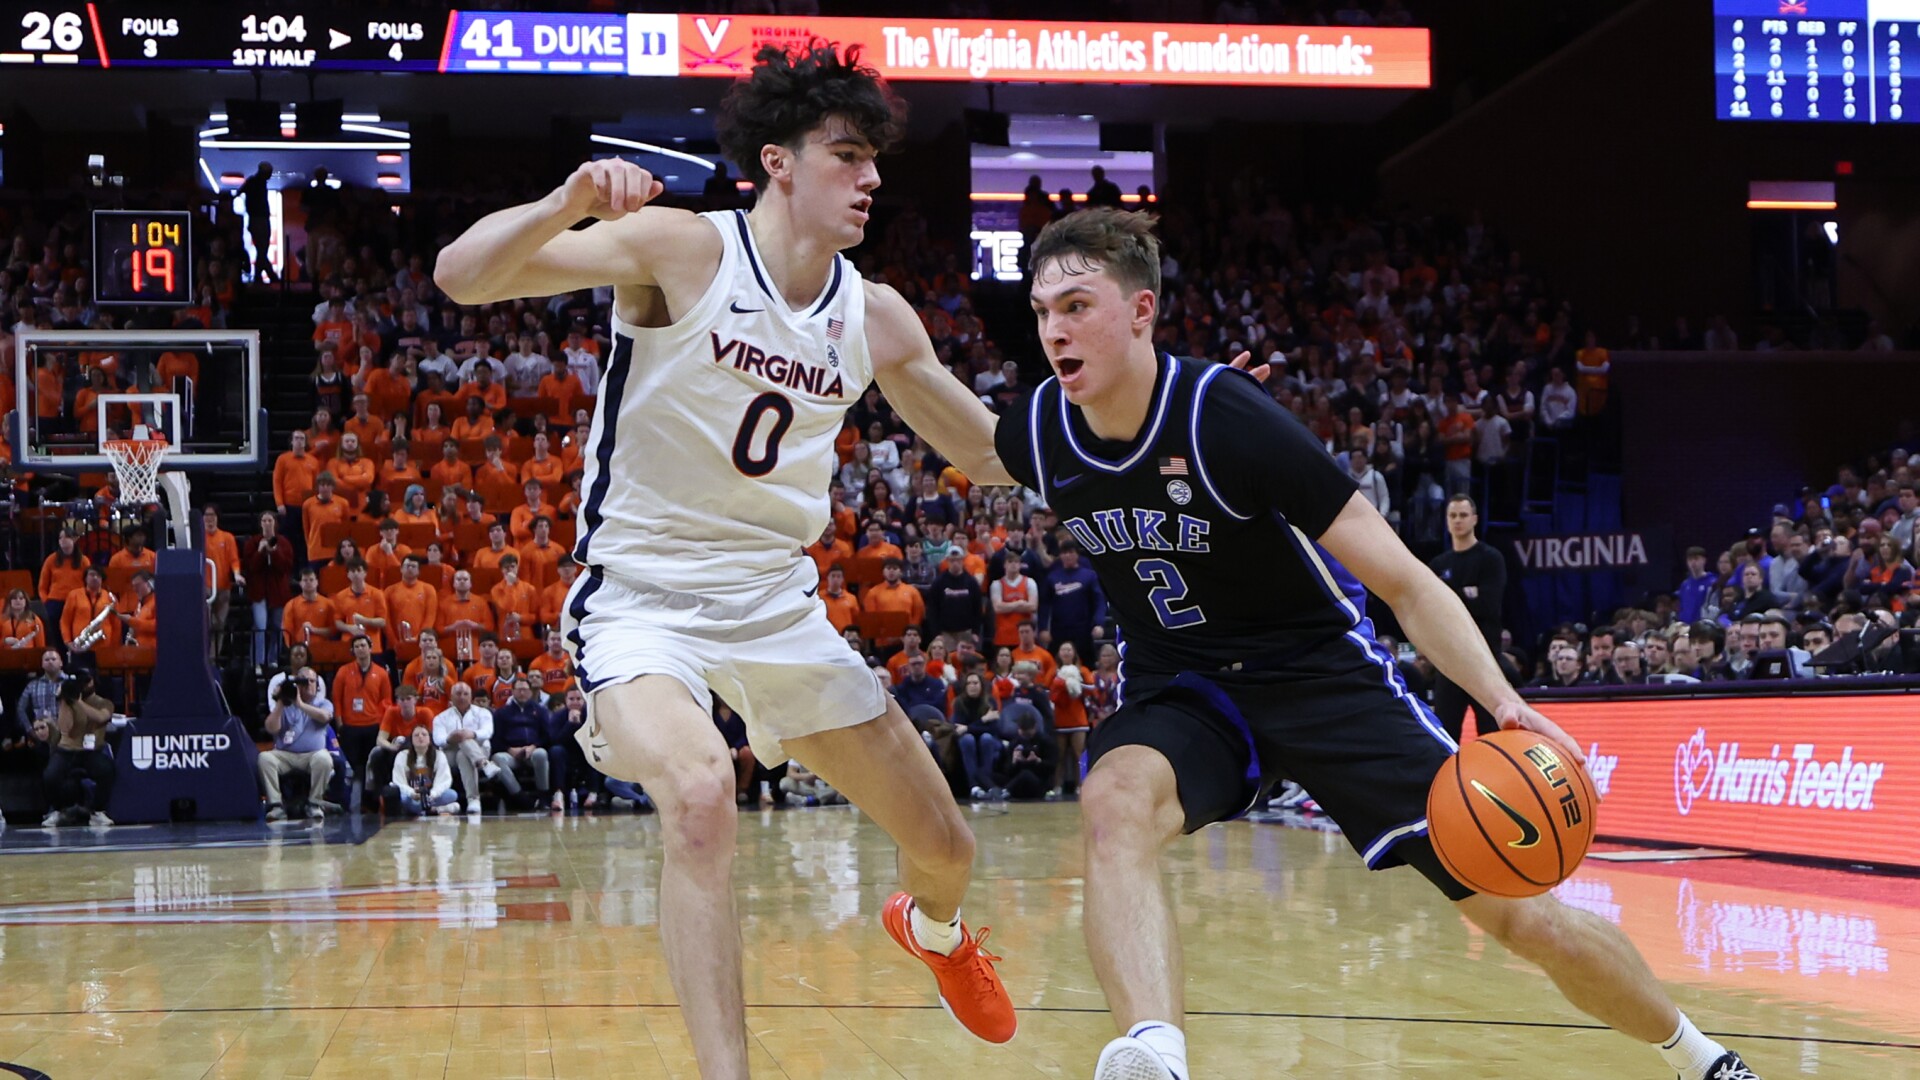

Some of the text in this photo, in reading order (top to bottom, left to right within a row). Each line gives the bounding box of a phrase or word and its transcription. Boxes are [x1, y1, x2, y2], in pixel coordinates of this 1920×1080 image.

[21, 11, 83, 51] 26
[122, 18, 179, 36] FOULS
[241, 15, 307, 43] 1:04
[368, 22, 424, 40] FOULS
[461, 18, 624, 57] 41 DUKE
[1769, 37, 1781, 53] 2
[1806, 38, 1818, 53] 1
[143, 39, 158, 58] 3
[232, 49, 316, 67] 1ST HALF
[388, 43, 403, 62] 4
[882, 26, 1373, 78] The Virginia Athletics Foundation funds:
[1769, 53, 1782, 69] 0
[1806, 54, 1818, 69] 1
[1766, 70, 1787, 86] 11
[1807, 71, 1819, 86] 2
[1770, 86, 1783, 101] 0
[1806, 87, 1819, 102] 0
[1730, 101, 1751, 117] 11
[131, 248, 174, 293] 19
[711, 330, 844, 399] VIRGINIA
[732, 391, 794, 478] 0
[1062, 507, 1210, 555] DUKE
[1514, 534, 1648, 568] VIRGINIA
[1133, 558, 1207, 630] 2
[154, 734, 230, 751] UNITED
[155, 752, 210, 769] BANK
[1708, 742, 1884, 810] Harris Teeter
